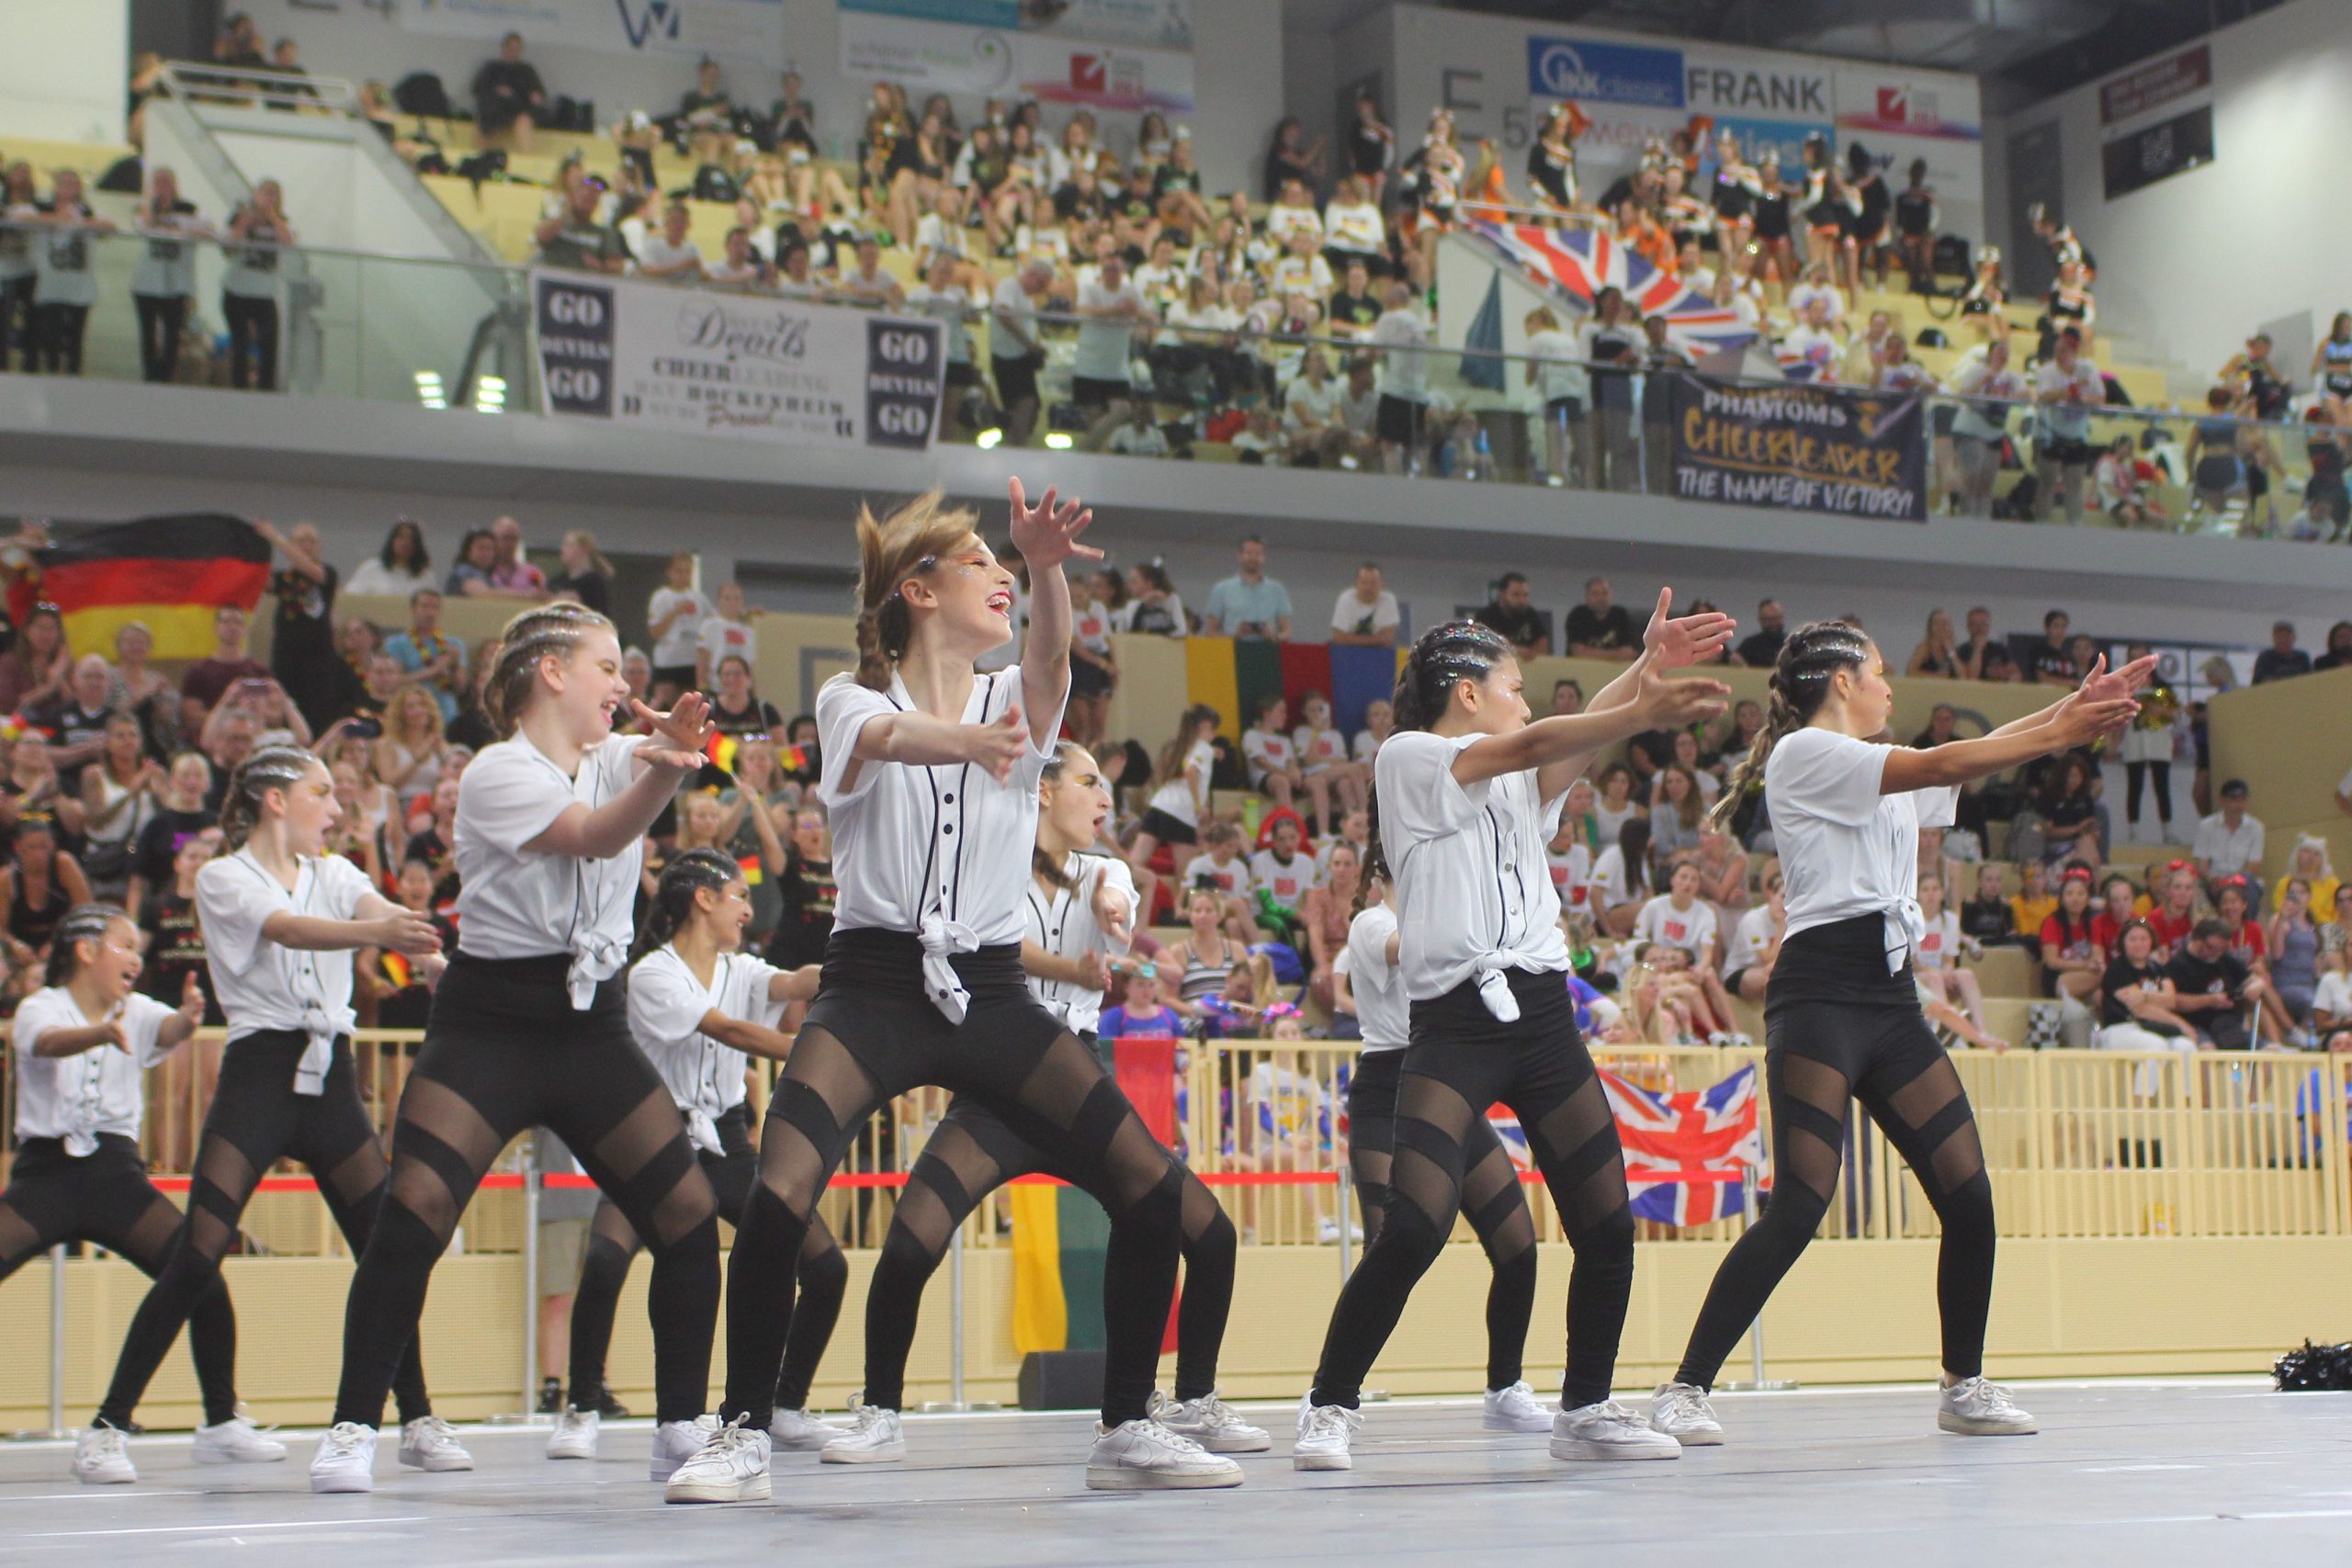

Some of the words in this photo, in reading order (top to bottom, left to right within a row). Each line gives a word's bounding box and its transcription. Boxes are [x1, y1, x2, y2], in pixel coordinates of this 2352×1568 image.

[1688, 68, 1825, 113] FRANK
[549, 293, 604, 327] GO
[879, 332, 929, 365] GO
[549, 367, 602, 400] GO
[870, 373, 936, 398] DEVILS
[878, 404, 927, 436] GO
[1702, 389, 1847, 427] PHANTOMS
[1678, 467, 1718, 497] THE
[1724, 472, 1792, 505] NAME
[1793, 476, 1822, 505] OF
